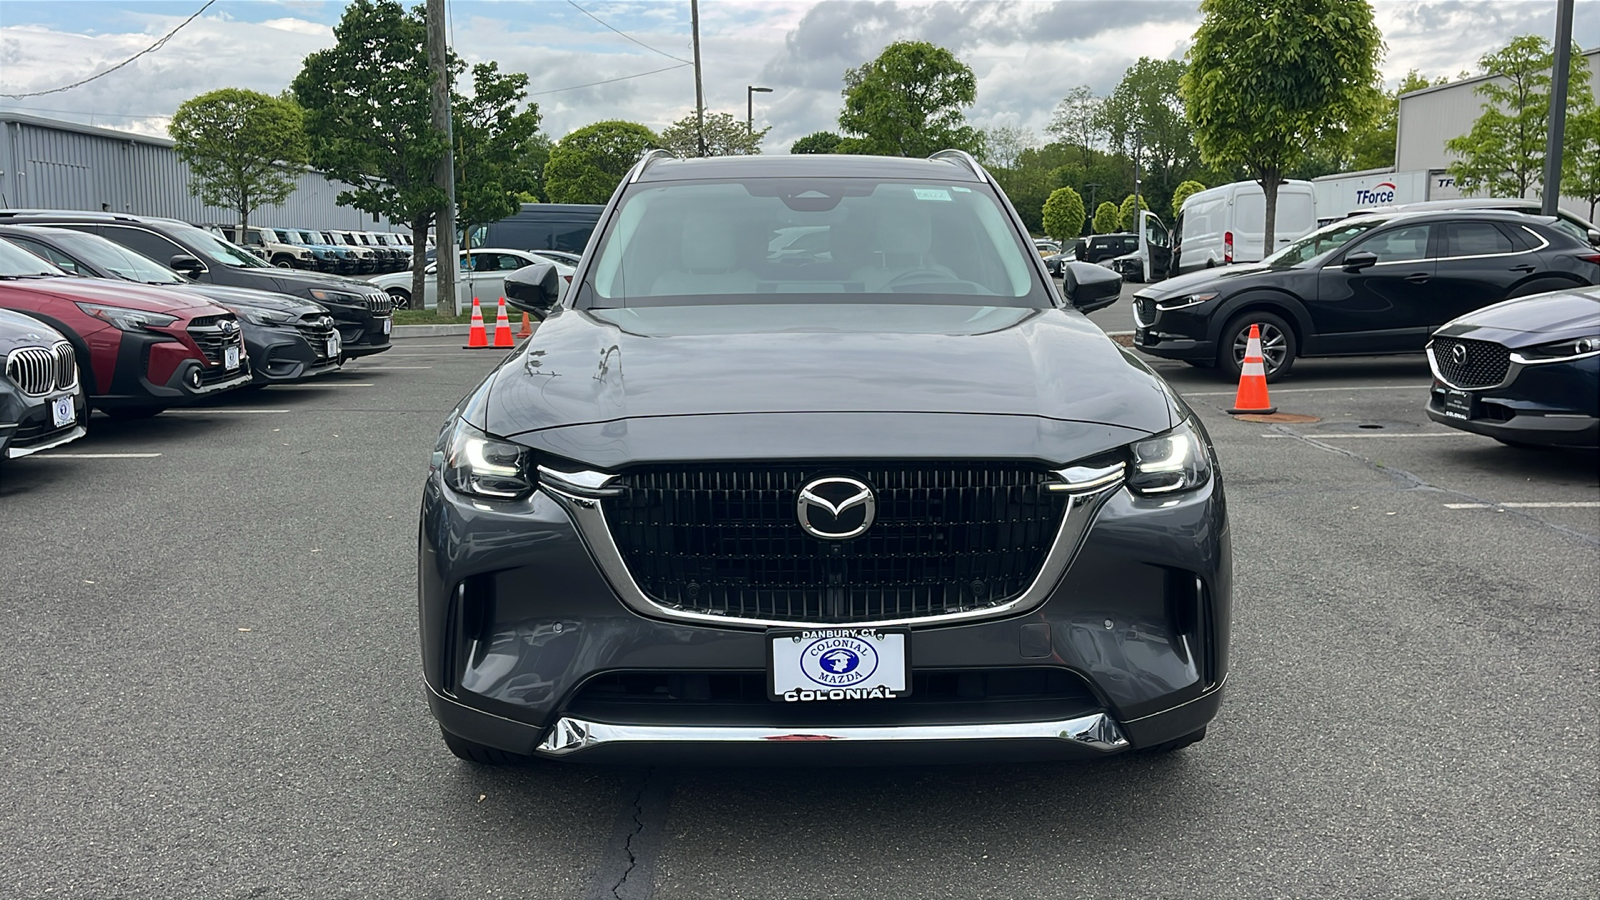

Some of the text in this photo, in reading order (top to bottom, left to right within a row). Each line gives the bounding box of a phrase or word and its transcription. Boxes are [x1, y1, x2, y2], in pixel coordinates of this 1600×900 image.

[1357, 190, 1394, 205] TForce
[860, 628, 877, 638] CT
[811, 639, 868, 656] COLONIAL
[818, 671, 863, 684] MAZDA
[784, 688, 896, 702] COLONIAL
